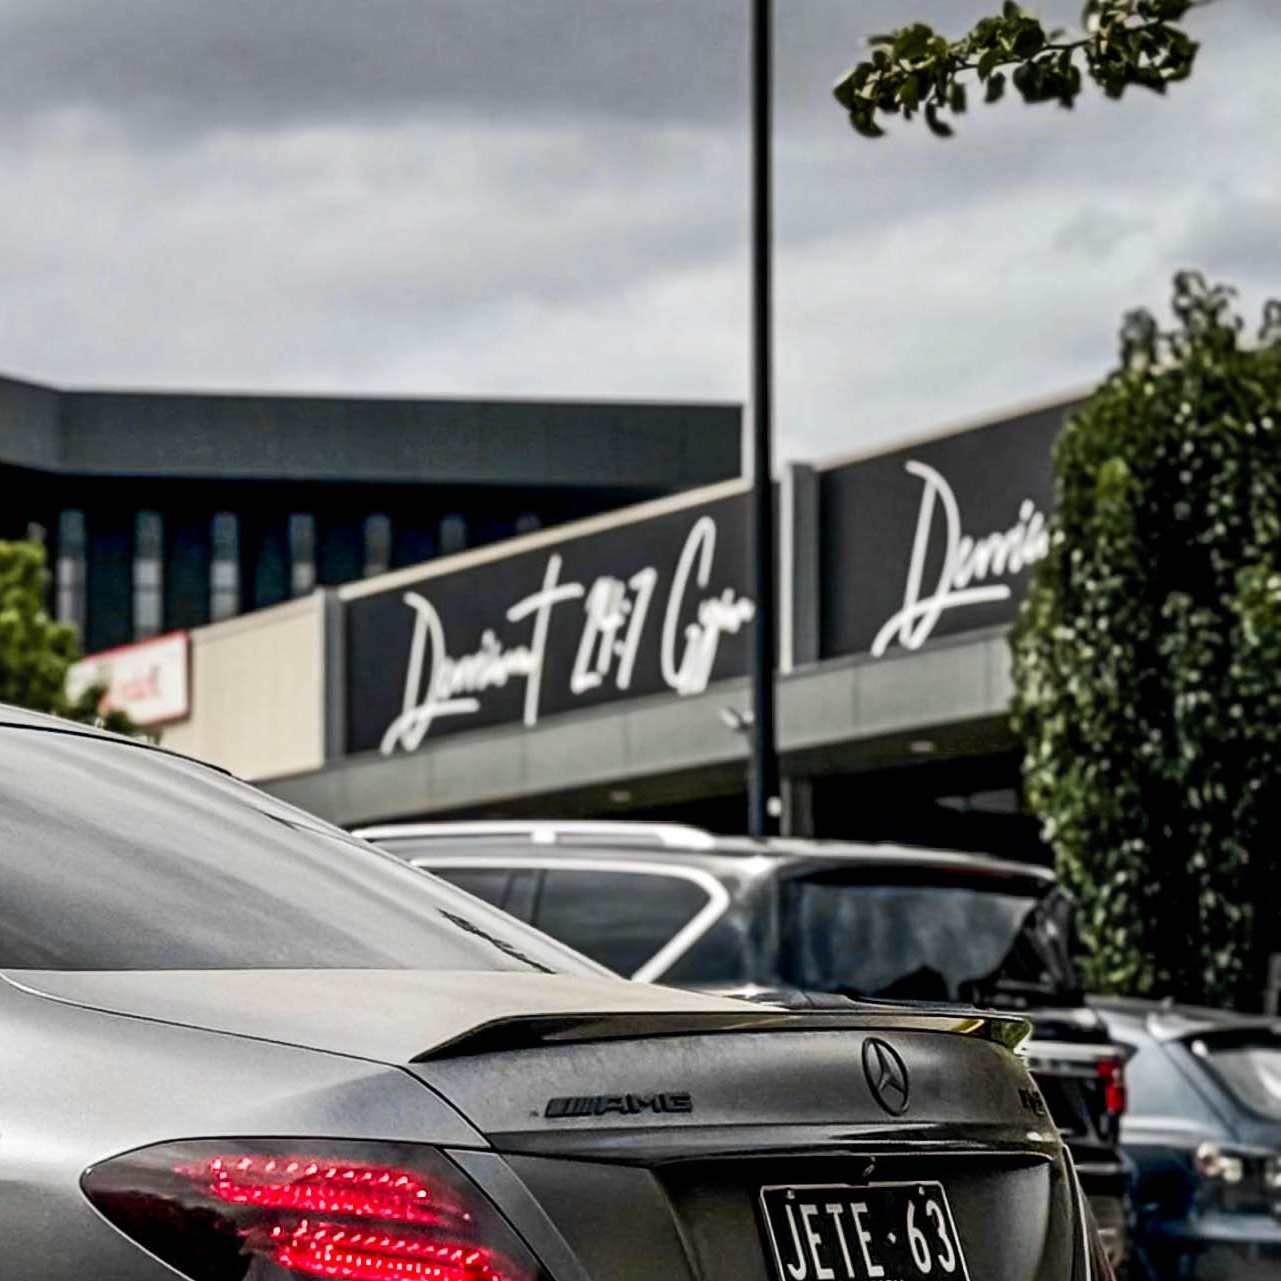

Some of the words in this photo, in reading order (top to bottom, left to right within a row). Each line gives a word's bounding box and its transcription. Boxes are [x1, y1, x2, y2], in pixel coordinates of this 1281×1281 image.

[594, 1093, 693, 1115] AMG
[785, 1201, 885, 1281] JETE
[907, 1199, 956, 1274] 63
